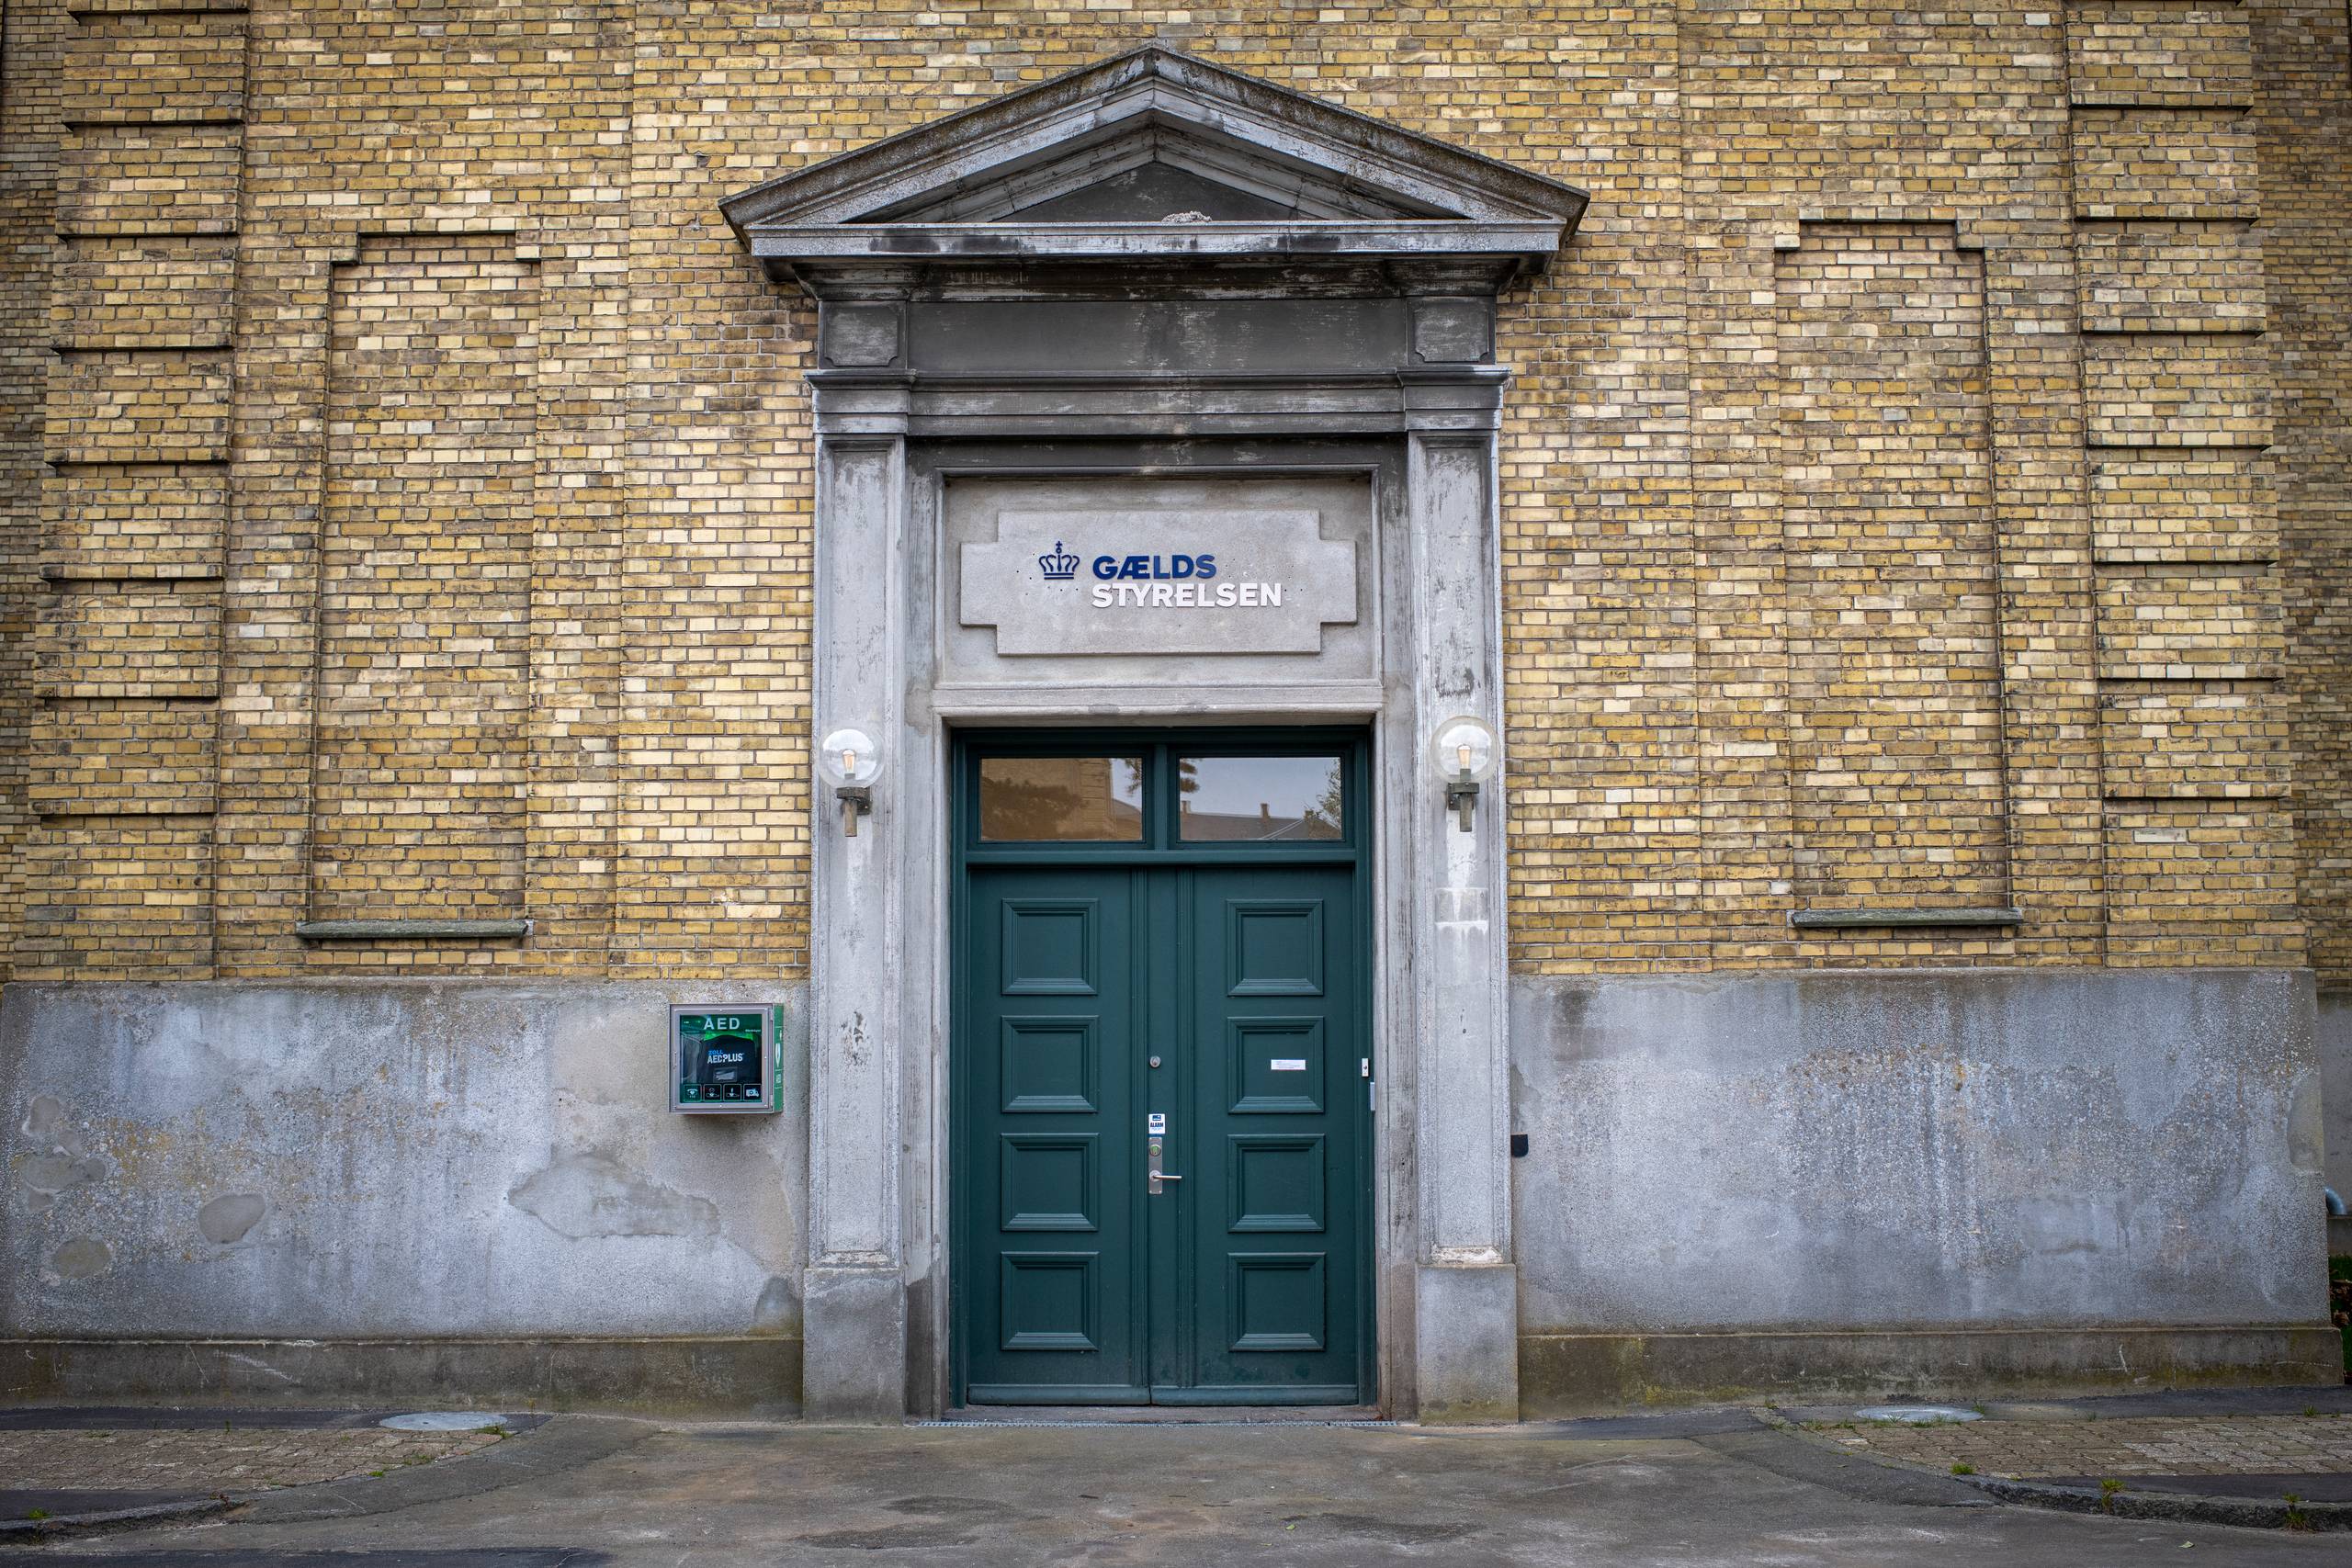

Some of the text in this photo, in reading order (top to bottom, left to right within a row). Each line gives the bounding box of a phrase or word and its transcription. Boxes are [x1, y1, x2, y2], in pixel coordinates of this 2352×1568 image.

[1092, 555, 1217, 580] GÆLDS
[1091, 582, 1283, 608] STYRELSEN
[703, 1017, 741, 1031] AED
